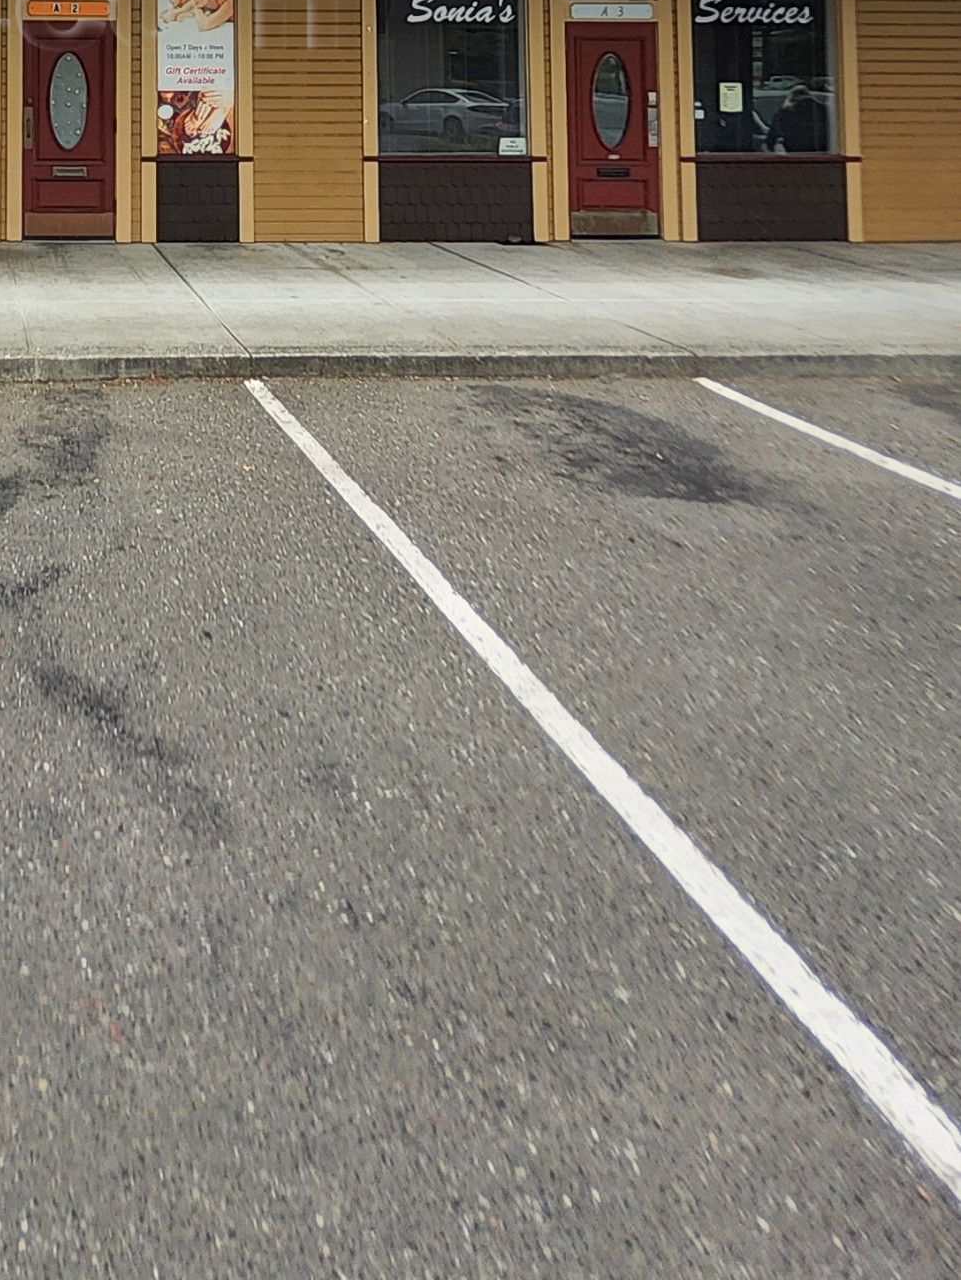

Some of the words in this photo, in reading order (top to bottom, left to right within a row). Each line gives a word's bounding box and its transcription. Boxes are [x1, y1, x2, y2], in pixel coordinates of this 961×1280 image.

[53, 3, 61, 13] A
[71, 3, 79, 13] 2
[600, 5, 609, 17] A
[616, 5, 624, 17] 3
[166, 67, 181, 75] Gift
[183, 67, 227, 75] Certificate
